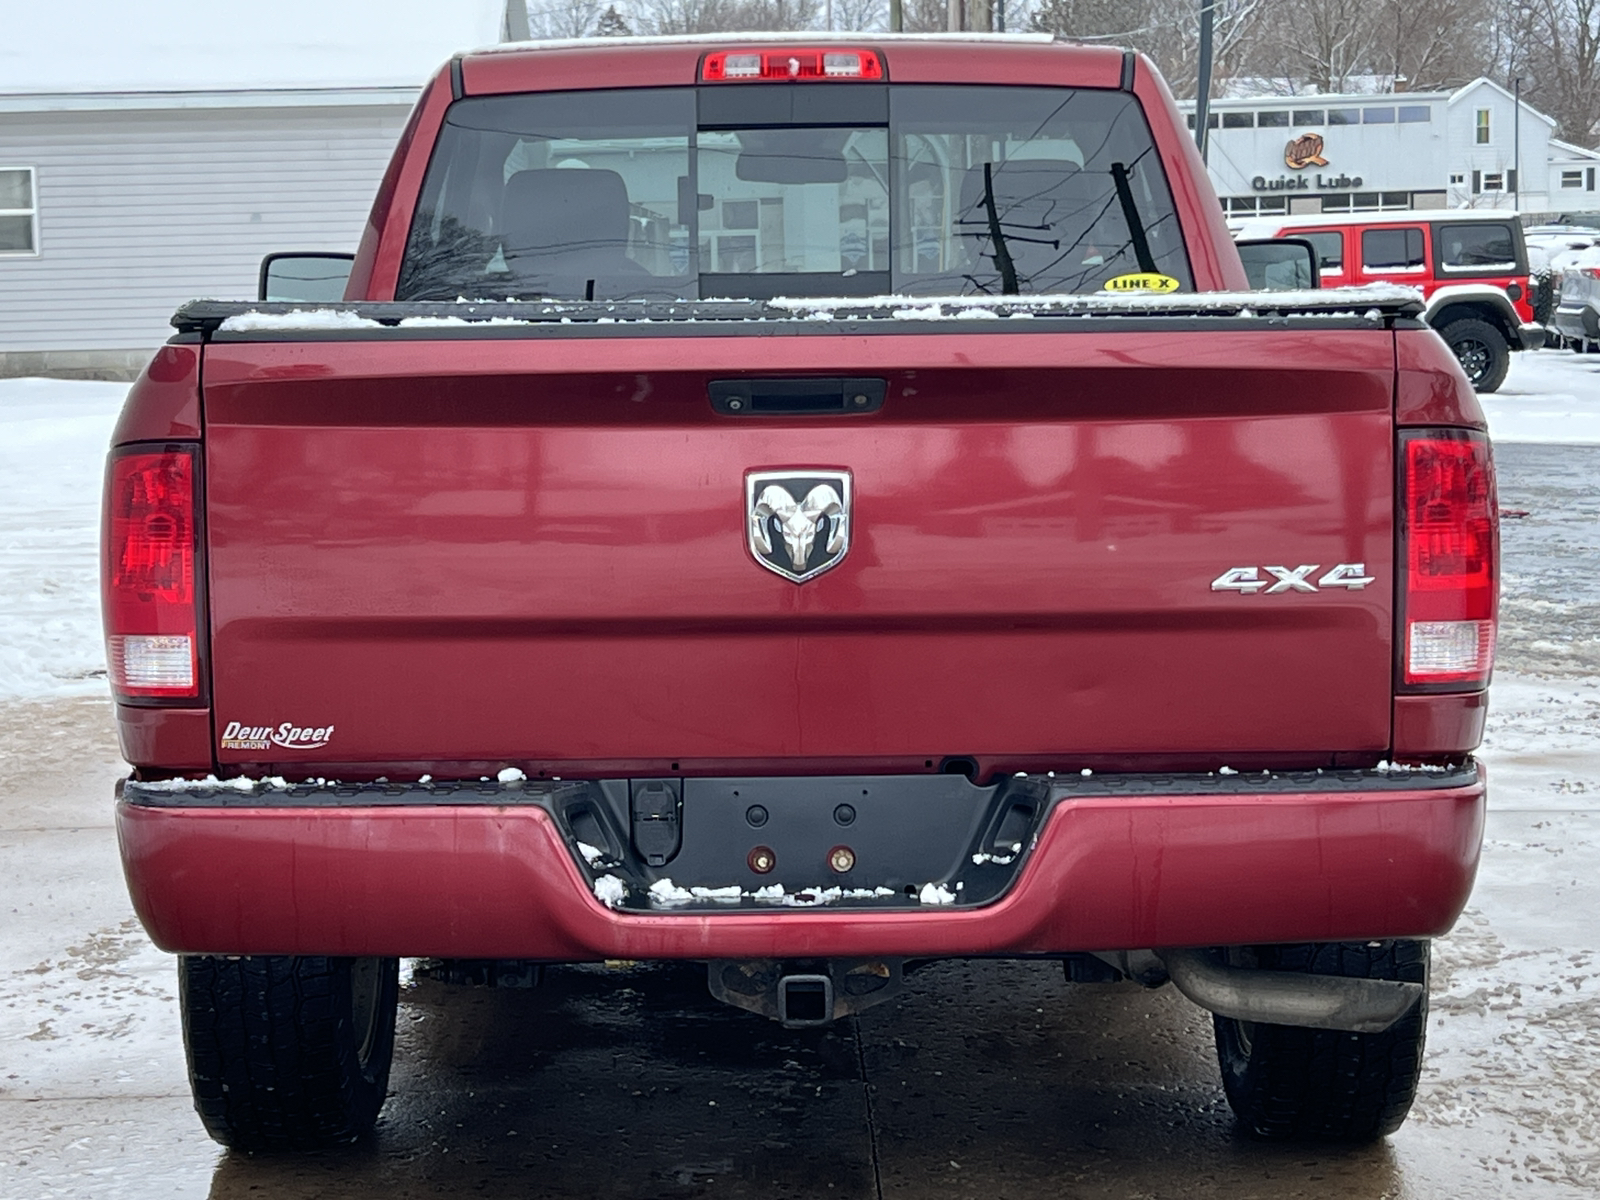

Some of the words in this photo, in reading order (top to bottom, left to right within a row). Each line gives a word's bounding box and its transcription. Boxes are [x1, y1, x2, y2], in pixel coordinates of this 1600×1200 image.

[1252, 174, 1308, 191] Quick
[1316, 173, 1363, 189] Lube
[221, 740, 271, 750] FREMONT
